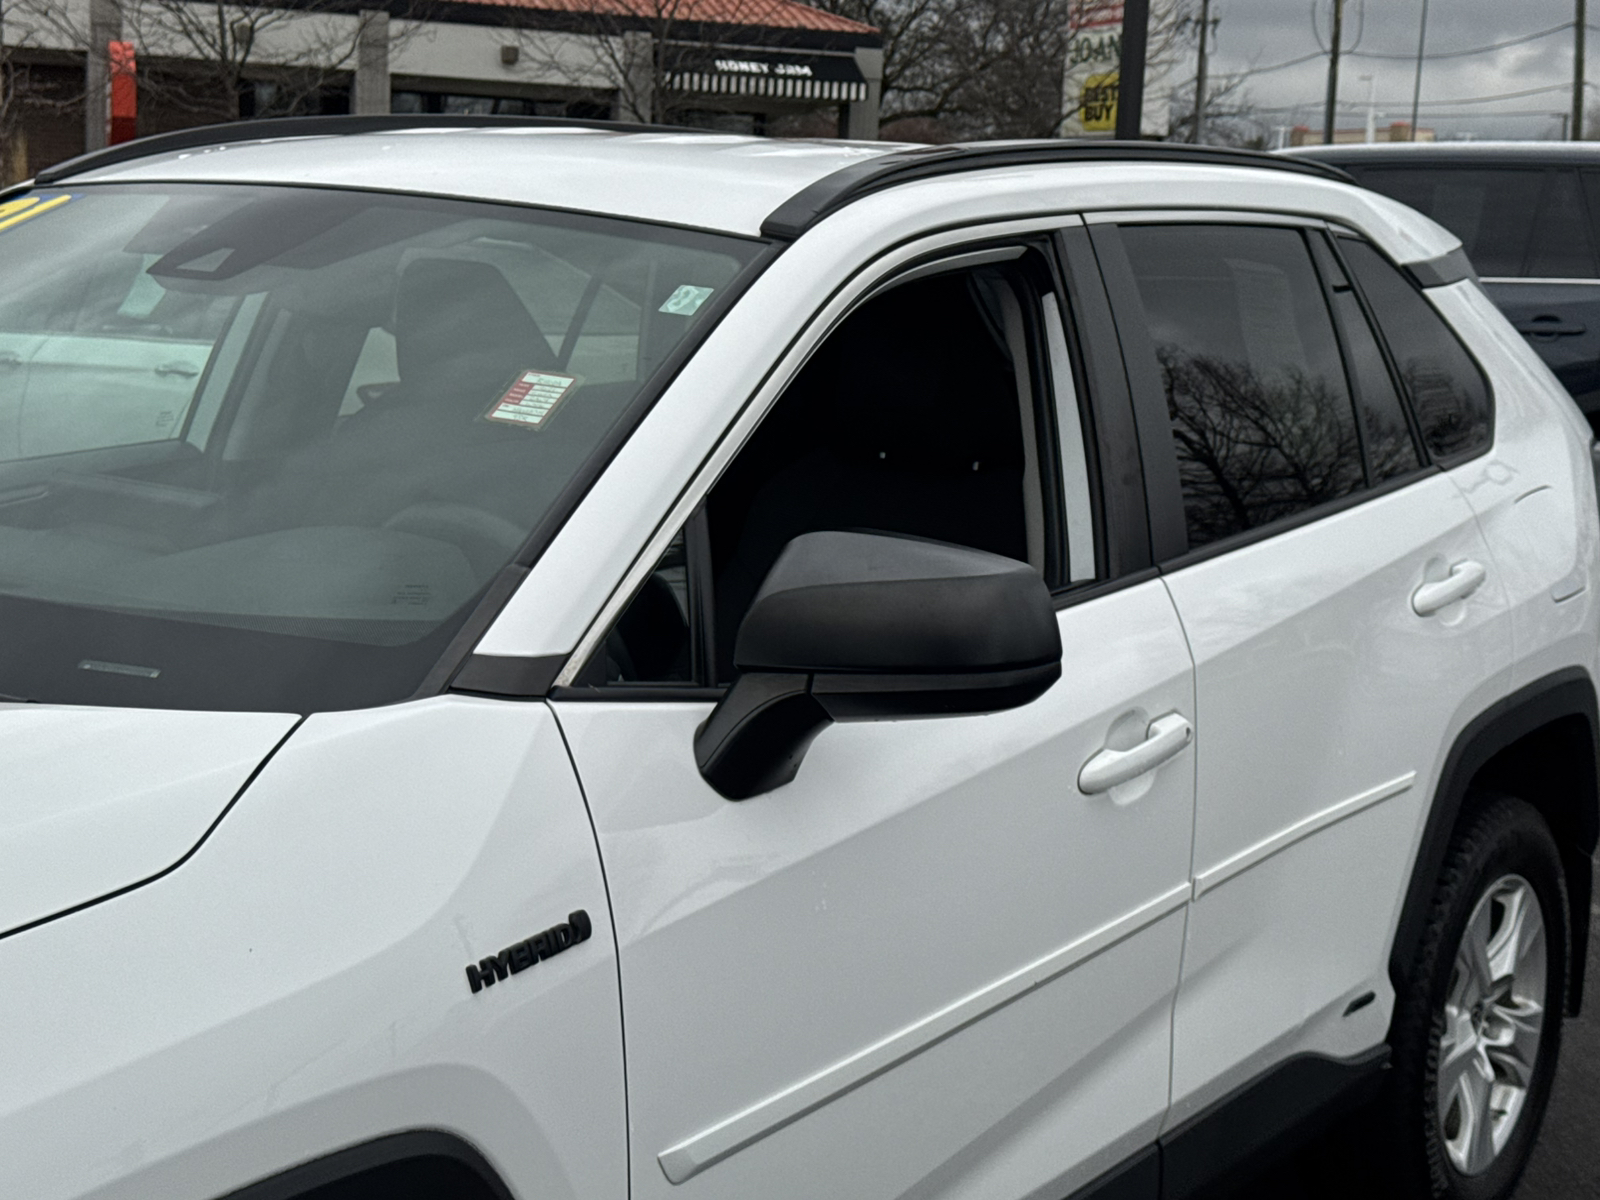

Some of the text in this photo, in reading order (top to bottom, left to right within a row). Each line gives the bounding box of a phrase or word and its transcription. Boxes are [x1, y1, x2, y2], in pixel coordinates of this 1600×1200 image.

[1084, 84, 1120, 103] BEST
[1084, 104, 1114, 122] BUY
[465, 922, 576, 994] HYBRID
